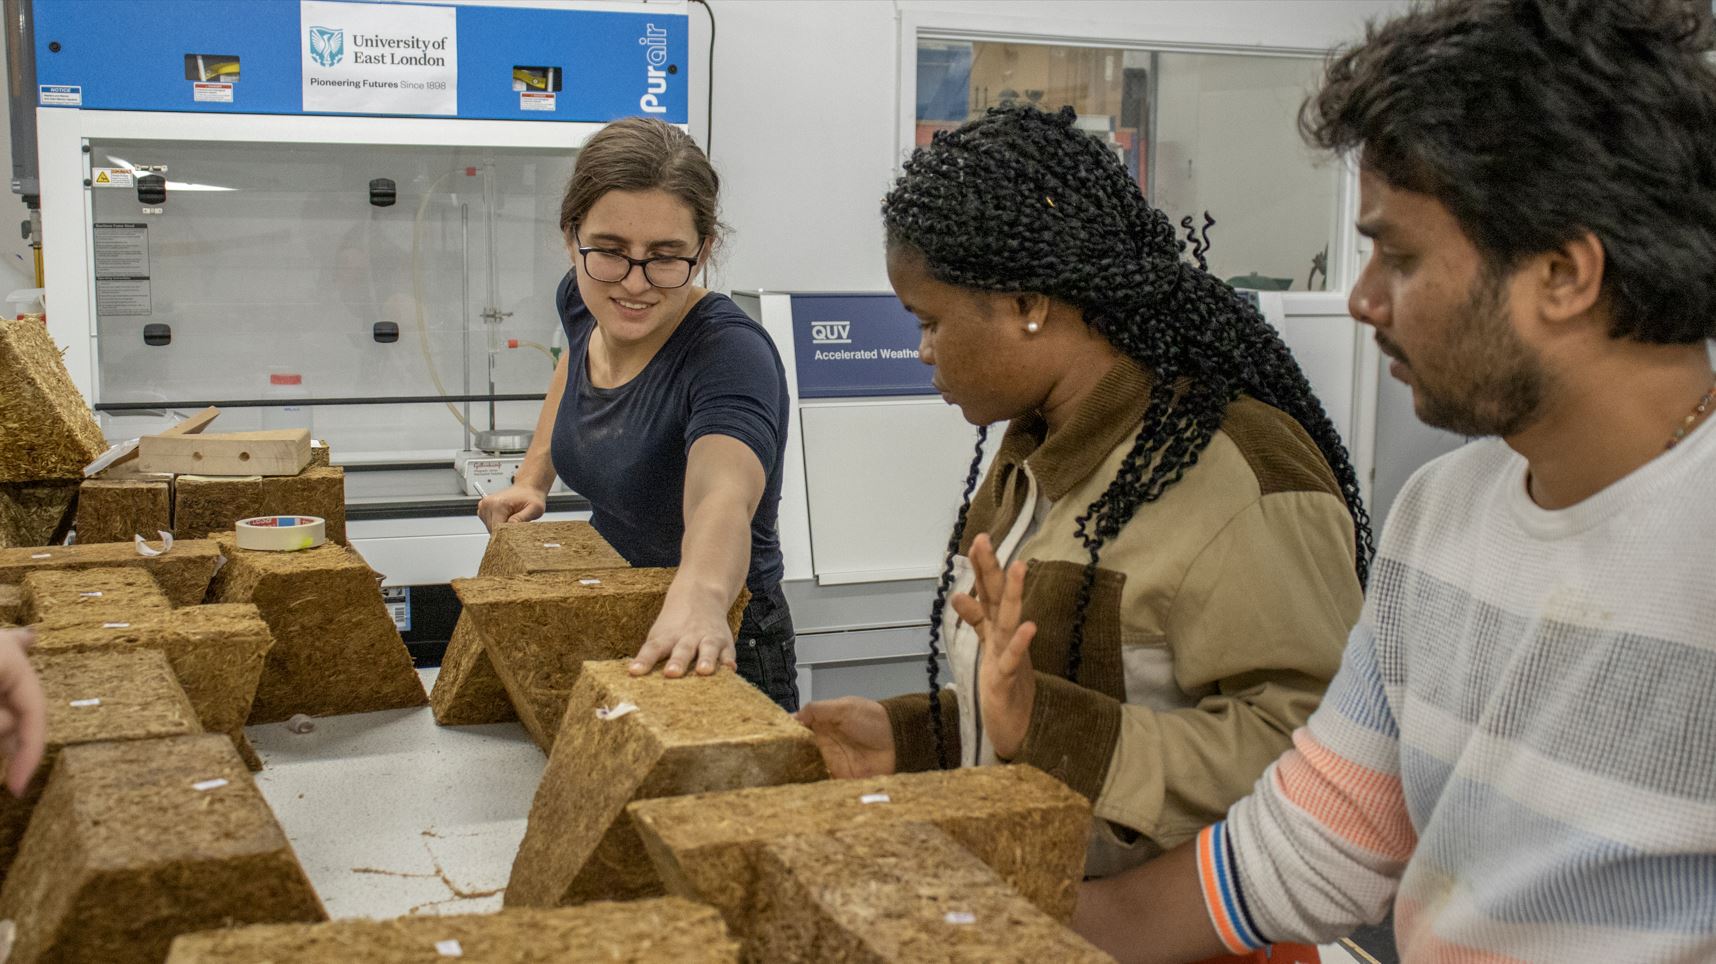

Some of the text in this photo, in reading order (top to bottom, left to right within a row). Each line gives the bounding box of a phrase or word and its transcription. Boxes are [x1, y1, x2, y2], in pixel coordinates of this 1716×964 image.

[353, 34, 448, 53] University of
[353, 50, 446, 67] East London
[639, 23, 667, 113] Purair
[310, 77, 447, 90] Pioneering Futures Since 1898
[811, 325, 851, 340] QUV
[815, 348, 920, 360] Accelerated Weathe
